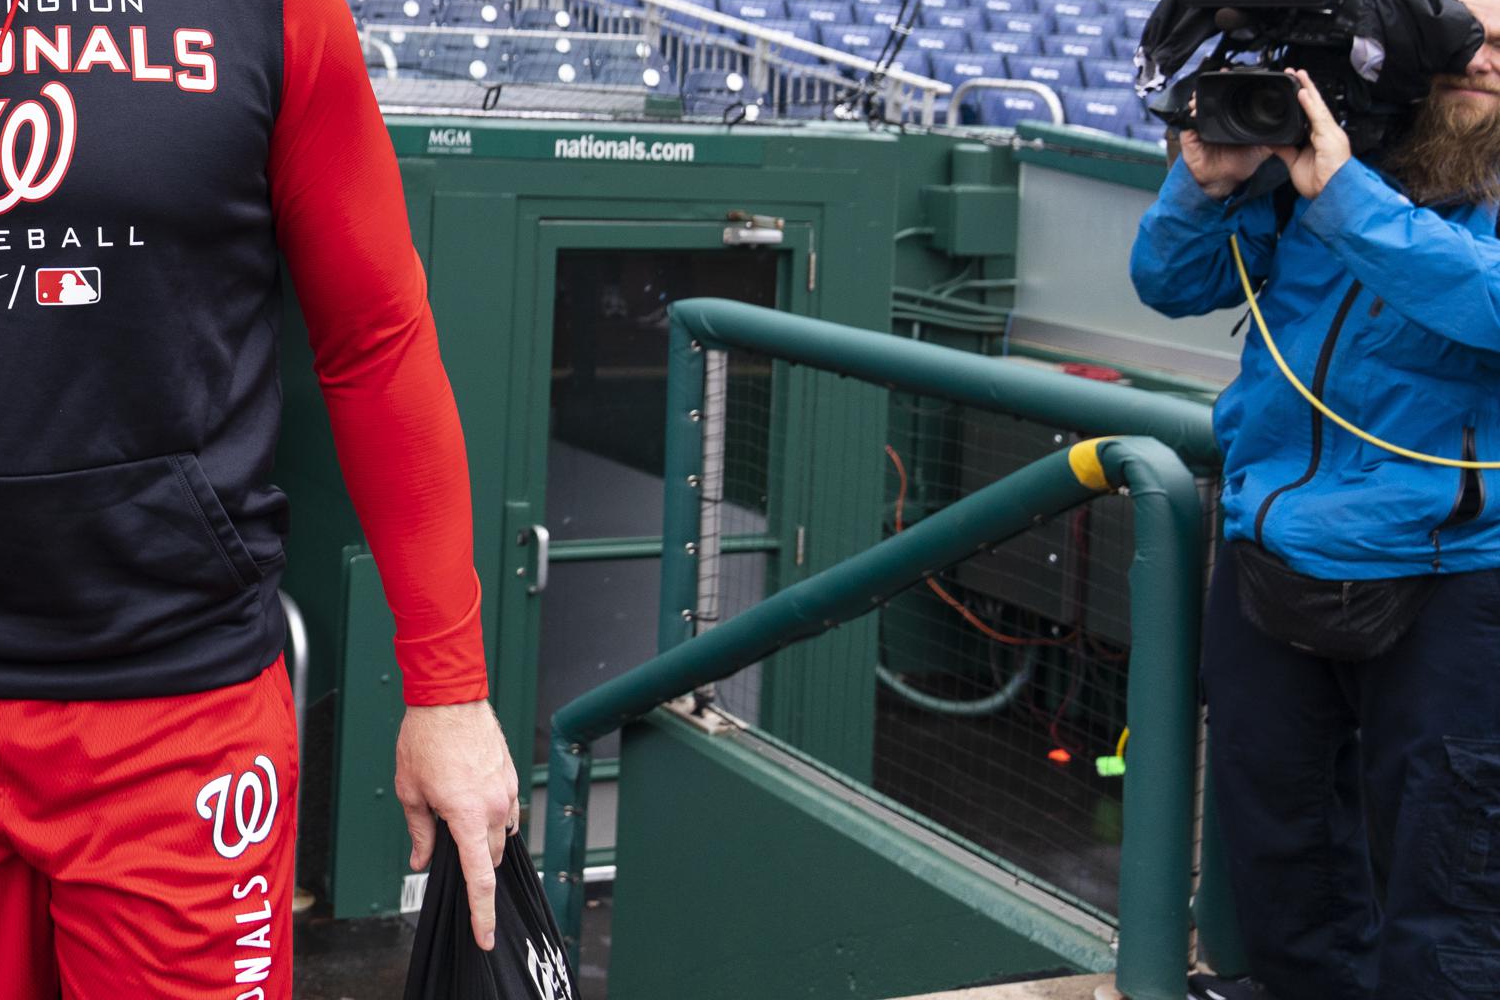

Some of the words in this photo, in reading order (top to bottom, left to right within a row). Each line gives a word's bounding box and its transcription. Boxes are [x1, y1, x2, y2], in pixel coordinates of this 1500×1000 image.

[428, 129, 472, 147] MGM
[554, 134, 695, 162] nationals.com
[195, 754, 279, 859] W
